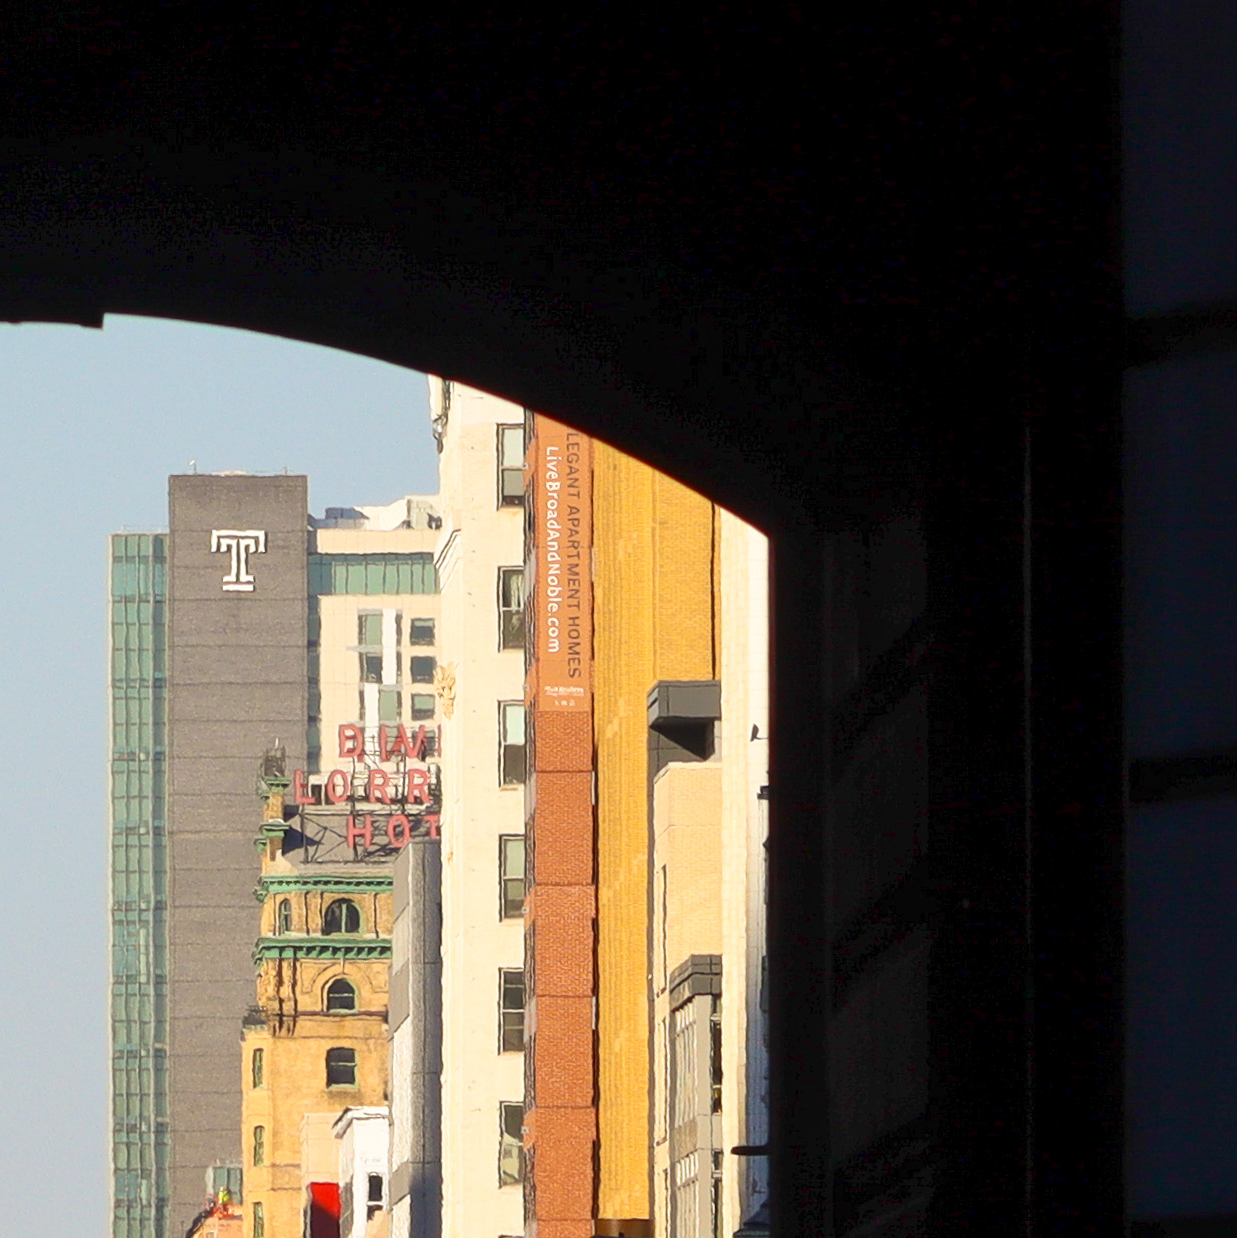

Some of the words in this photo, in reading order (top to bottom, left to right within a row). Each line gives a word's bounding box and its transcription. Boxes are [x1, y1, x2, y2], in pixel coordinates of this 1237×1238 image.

[210, 528, 266, 592] T
[545, 446, 563, 653] LiveBroadAndNoble.com
[566, 505, 581, 611] APARTMENT
[566, 616, 582, 678] HOMES
[294, 768, 431, 804] LORR
